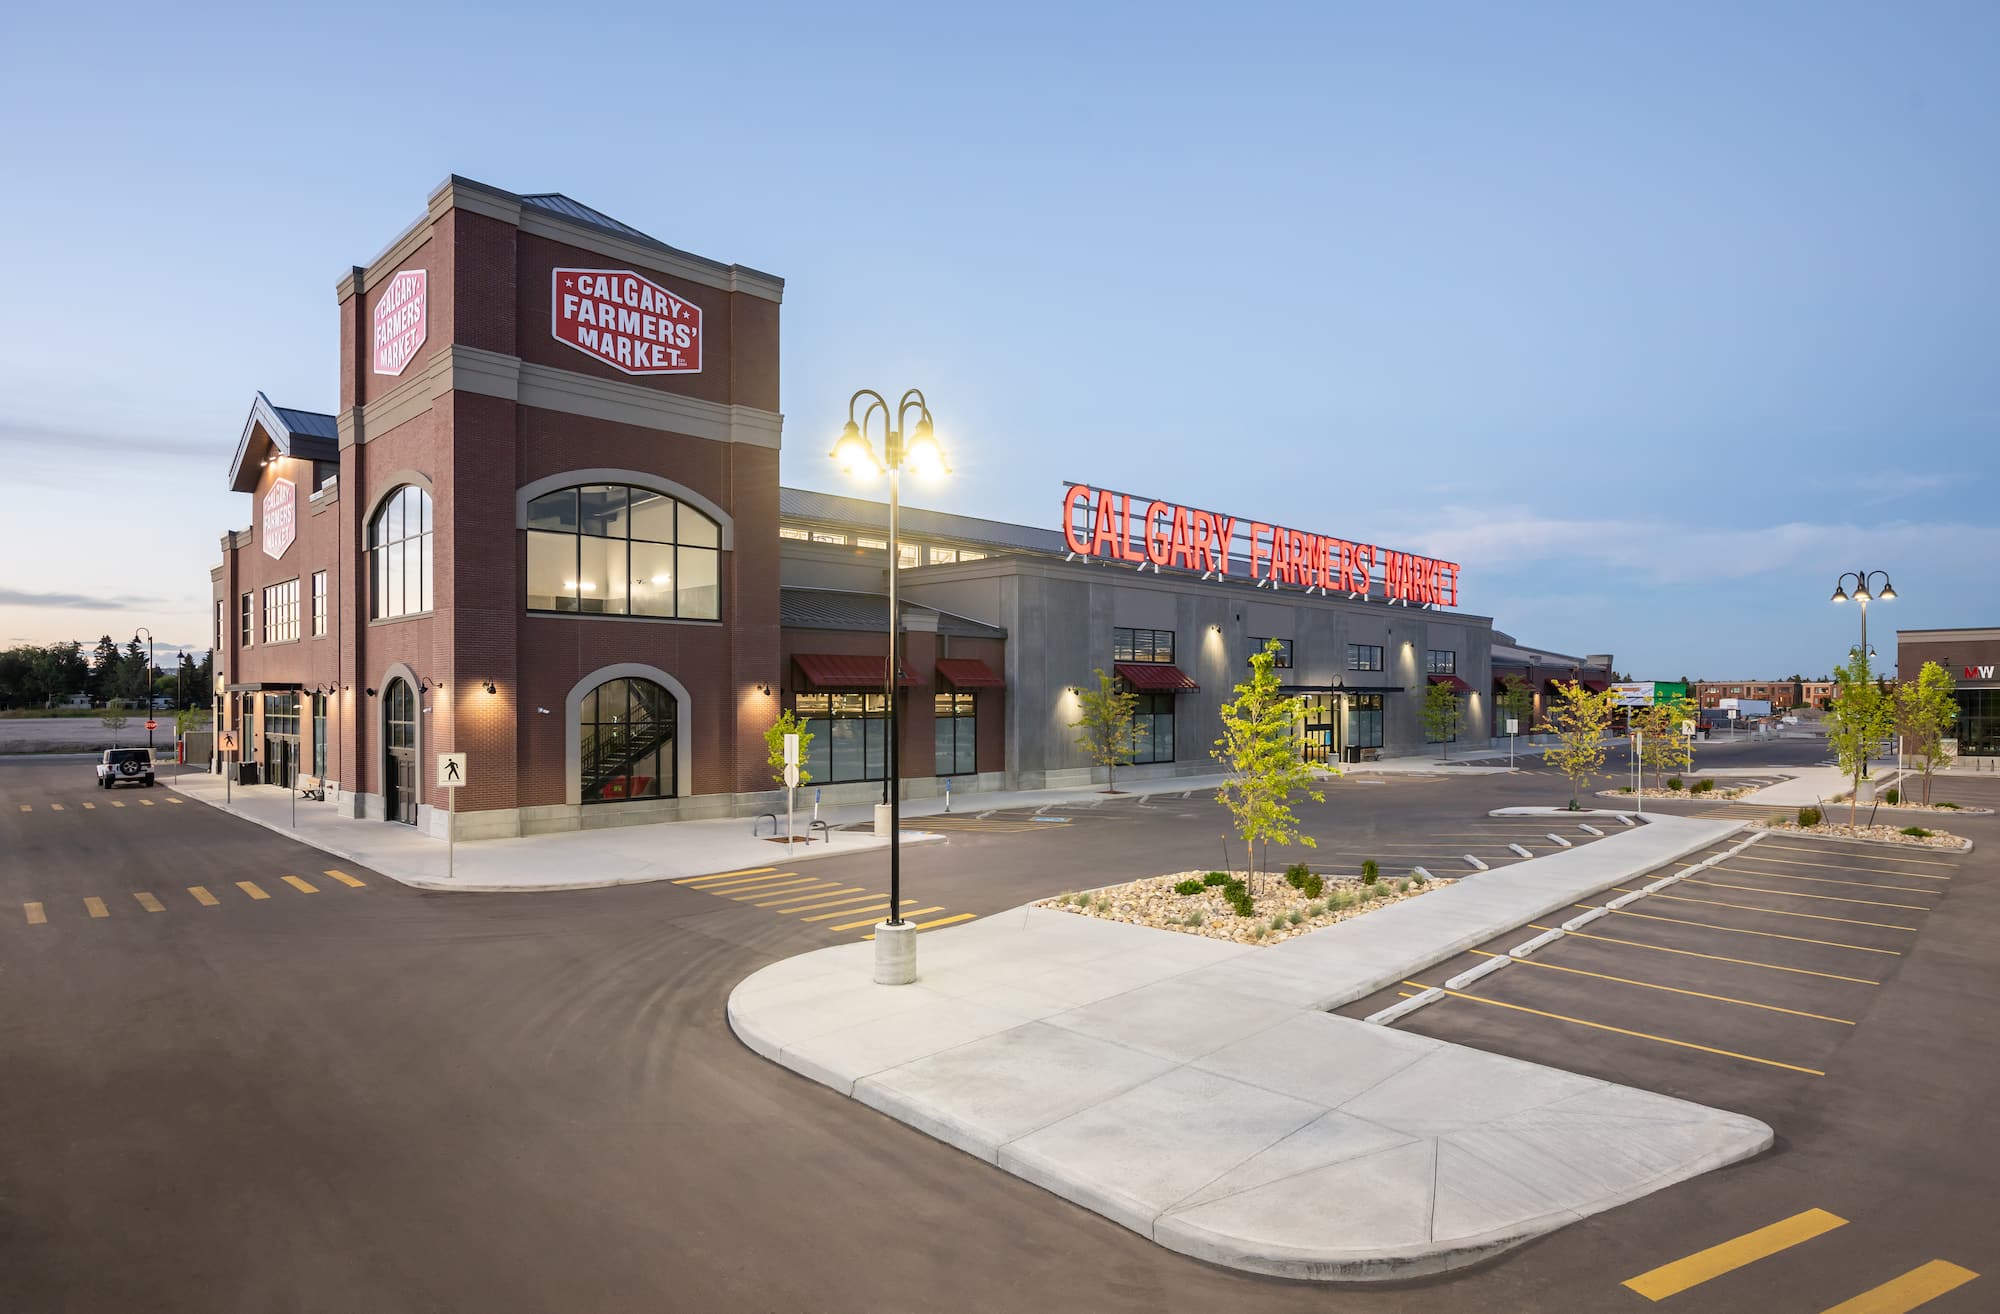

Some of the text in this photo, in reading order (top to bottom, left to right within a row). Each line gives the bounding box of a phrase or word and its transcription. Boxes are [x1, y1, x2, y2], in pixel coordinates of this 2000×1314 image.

[381, 277, 417, 318] CALGARY
[577, 276, 682, 319] CALGARY
[376, 294, 425, 349] FARMERS'
[563, 293, 698, 348] FARMERS'
[381, 328, 417, 369] MARKET
[578, 326, 682, 368] MARKET
[1063, 484, 1461, 607] CALGARY FARMERS' MARKET
